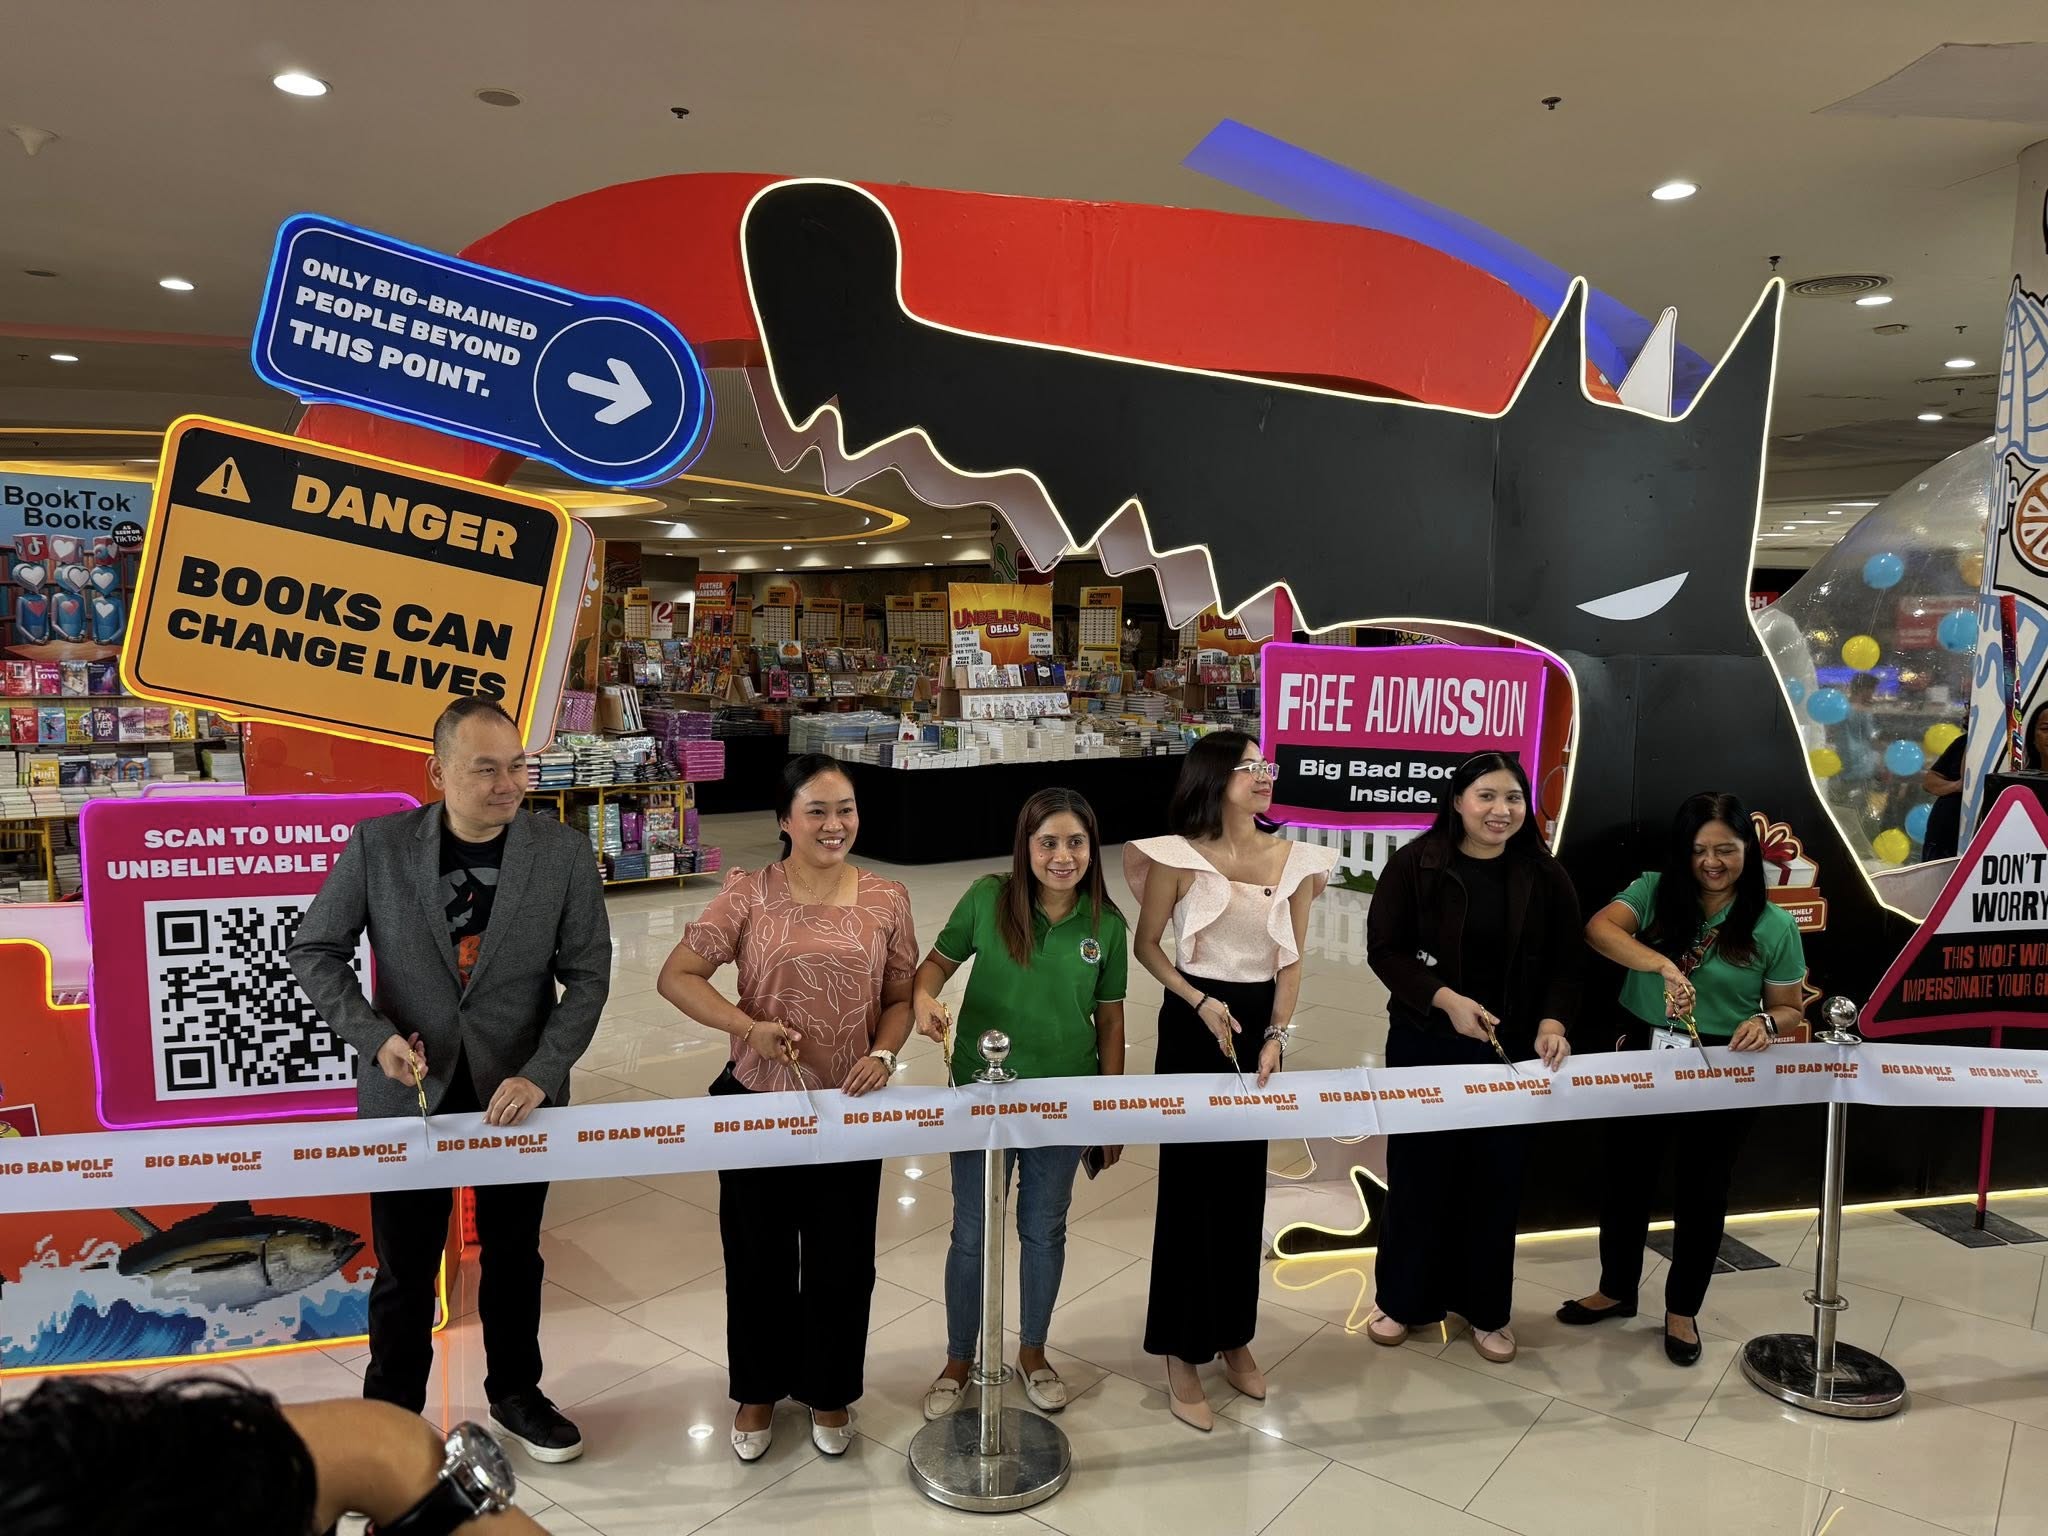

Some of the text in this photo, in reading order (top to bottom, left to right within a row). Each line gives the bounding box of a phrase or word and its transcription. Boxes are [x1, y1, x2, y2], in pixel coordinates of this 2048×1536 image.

[302, 257, 538, 342] ONLY BIG-BRAINED
[295, 286, 521, 367] PEOPLE BEYOND
[289, 318, 490, 398] THIS POINT.
[4, 485, 131, 512] BookTok
[24, 507, 112, 531] Books
[291, 474, 518, 560] DANGER
[115, 535, 144, 543] TikTok
[176, 555, 513, 662] BOOKS CAN
[953, 608, 1051, 630] UNBELIEVABLE
[990, 623, 1019, 634] DEALS
[167, 607, 507, 701] CHANGE LIVES
[1277, 672, 1528, 738] FREE ADMISSION
[1300, 760, 1341, 780] Big
[1349, 761, 1401, 777] Bad
[1350, 786, 1437, 803] Inside.
[143, 823, 356, 849] SCAN TO UNLO
[107, 853, 328, 880] UNBELIEVABLE
[1981, 852, 2048, 886] DON'T
[1972, 891, 2048, 924] WORRY
[1795, 915, 1813, 923] OOKS
[1942, 943, 2048, 970] THIS WOLF WO
[1903, 974, 1993, 1003] IMPERSONATE
[1997, 973, 2032, 998] YOUR
[1674, 1066, 1754, 1080] BIG BAD WOLF
[1776, 1062, 1858, 1074] BIG BAD WOLF
[1882, 1064, 1952, 1076] BIG BAD WOLF
[1969, 1068, 2039, 1078] BIG BAD WOLF
[1464, 1078, 1550, 1094] BIG BAD WOLF
[1572, 1072, 1653, 1086] BIG BAD WOLF
[1209, 1094, 1296, 1107] BIG BAD WOLF
[1320, 1090, 1370, 1102] BIG BAD
[1379, 1087, 1441, 1100] BAD WOLF
[971, 1102, 1068, 1116] BIG BAD WOLF
[1093, 1097, 1184, 1110] BIG BAD WOLF
[714, 1116, 818, 1133] BIG BAD WOLF
[844, 1108, 944, 1125] BIG BAD WOLF
[577, 1124, 685, 1143] BIG BAD WOLF
[658, 1136, 685, 1144] BOOKS
[791, 1128, 818, 1136] BOOKS
[437, 1134, 548, 1152] BIG BAD WOLF
[519, 1146, 548, 1154] BOOKS
[145, 1151, 262, 1168] BIG BAD WOLF
[293, 1143, 407, 1161] BIG BAD WOLF
[27, 1161, 64, 1174] BAD
[67, 1158, 113, 1172] WOLF
[232, 1164, 262, 1172] BOOKS
